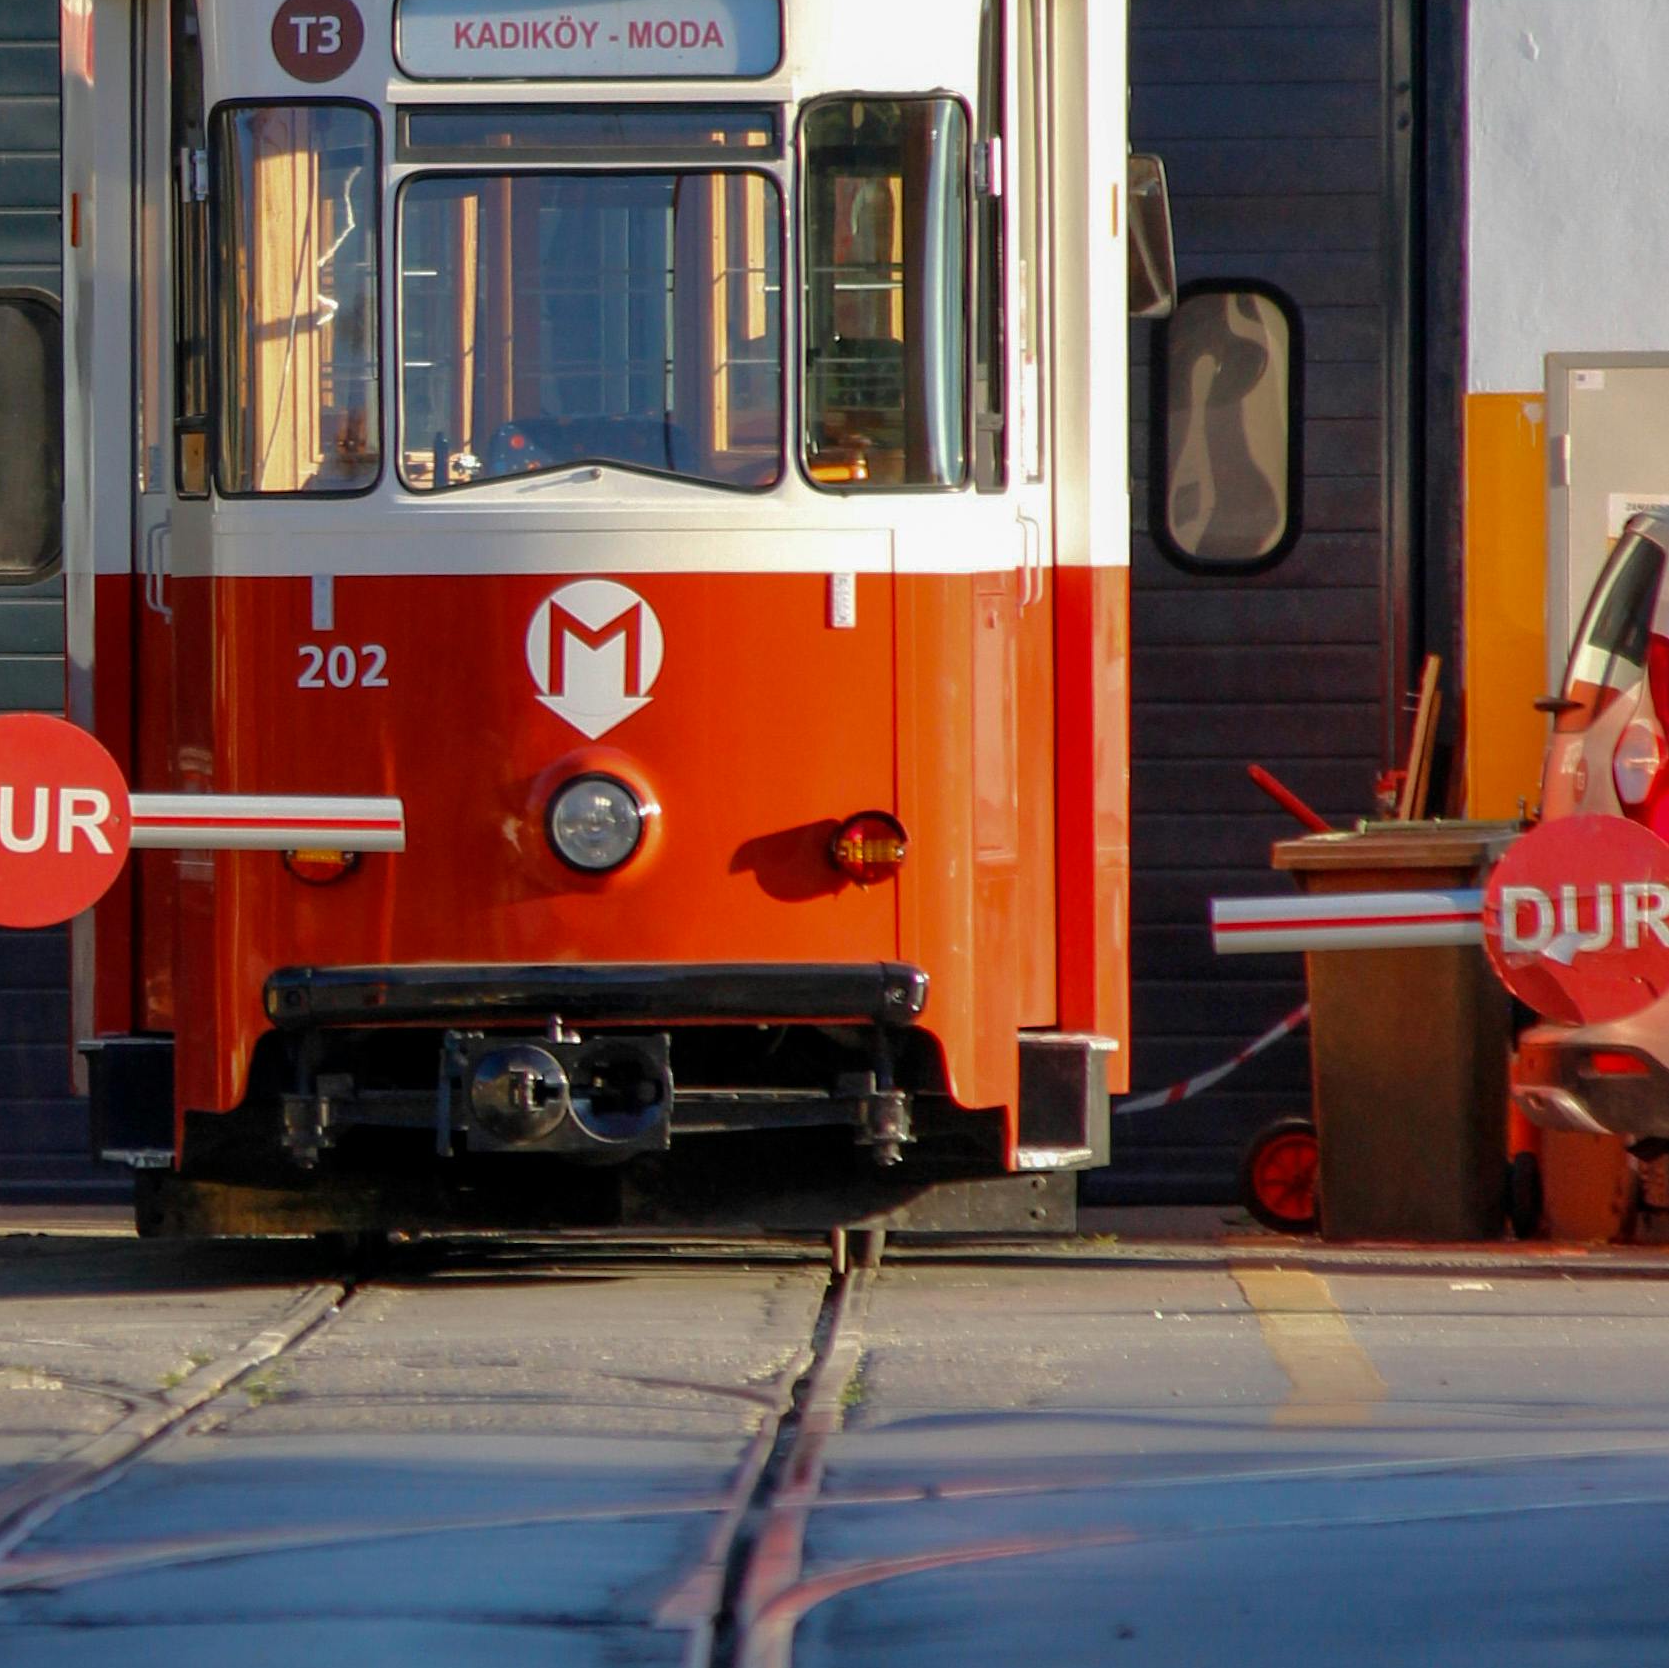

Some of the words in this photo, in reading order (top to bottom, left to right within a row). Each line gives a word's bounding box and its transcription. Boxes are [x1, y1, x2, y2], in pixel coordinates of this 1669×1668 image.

[289, 15, 342, 55] T3
[453, 15, 598, 50] KADIKÖY
[628, 20, 725, 50] MODA
[297, 645, 390, 690] 202
[1502, 882, 1669, 953] DUR
